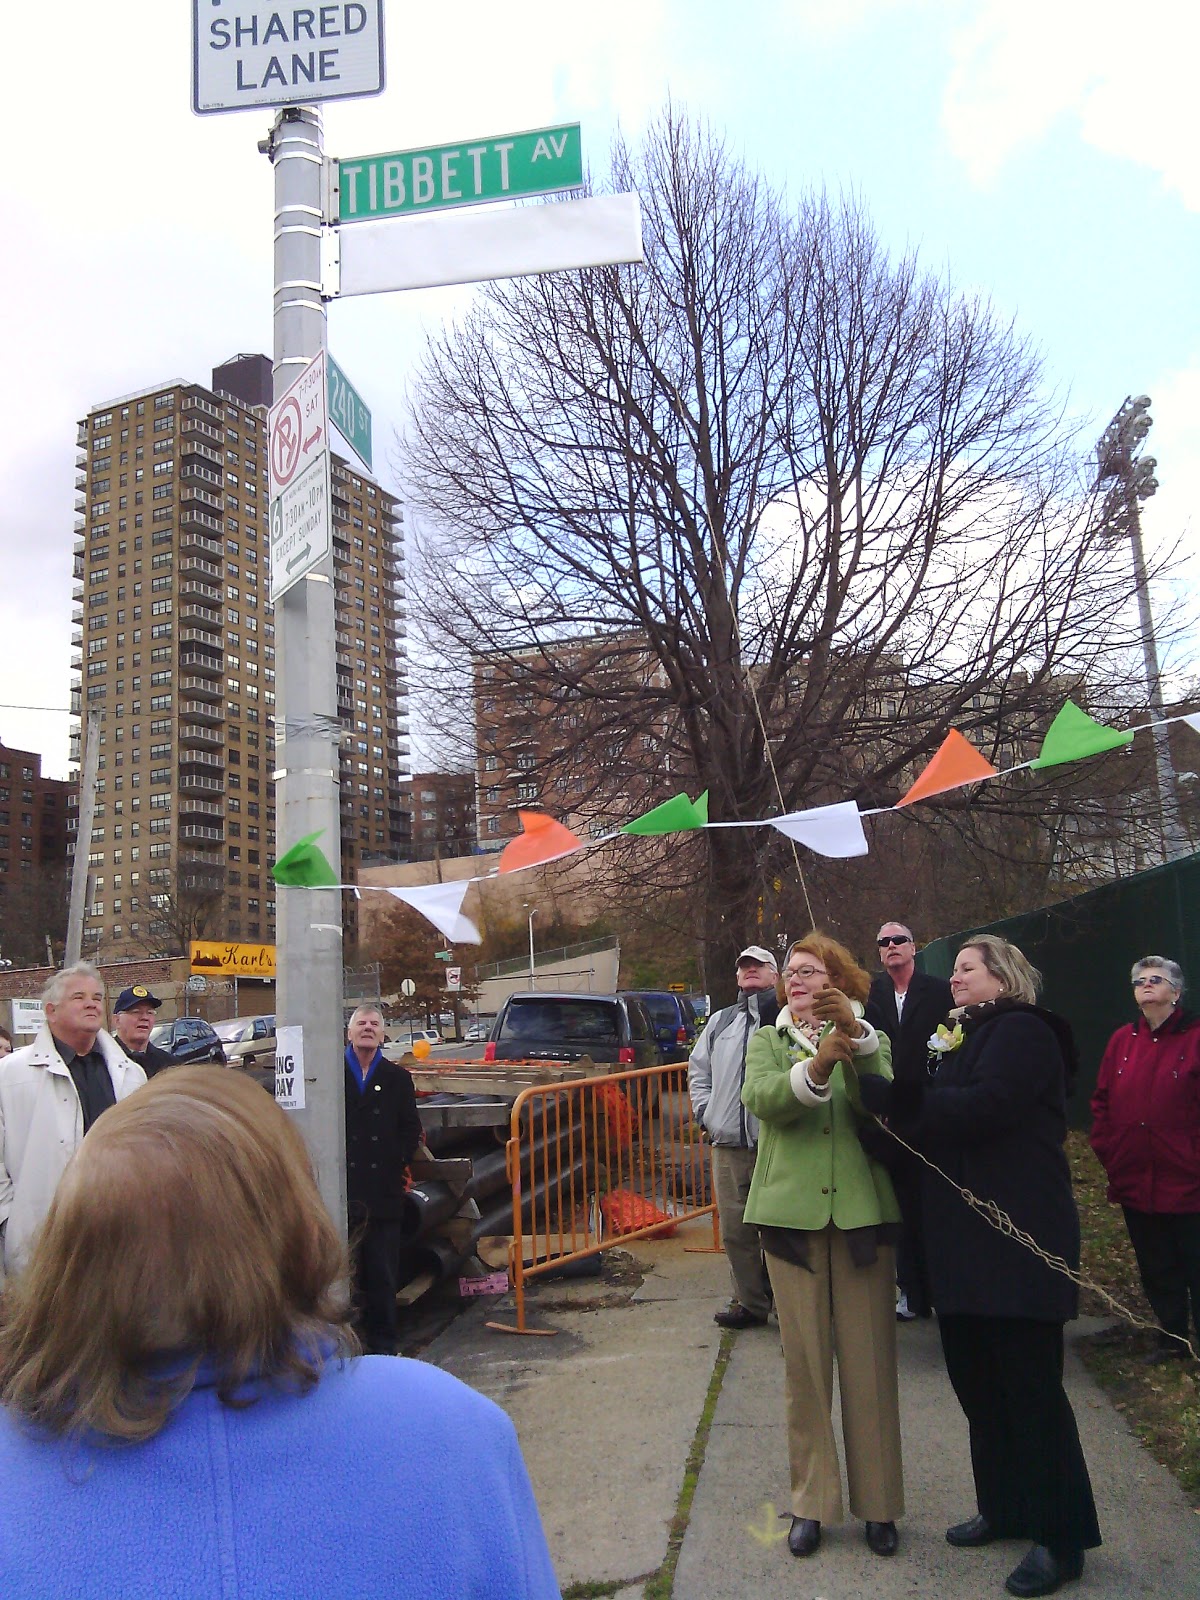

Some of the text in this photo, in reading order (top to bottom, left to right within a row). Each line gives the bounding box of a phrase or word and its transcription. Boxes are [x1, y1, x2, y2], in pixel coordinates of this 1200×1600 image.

[209, 3, 367, 50] SHARED
[236, 48, 341, 91] LANE
[343, 133, 568, 214] TIBBETT AV
[305, 392, 319, 418] SAT
[331, 369, 369, 438] 240 ST
[276, 508, 322, 563] EXCEPT SUNDAY
[222, 944, 272, 967] Karl's
